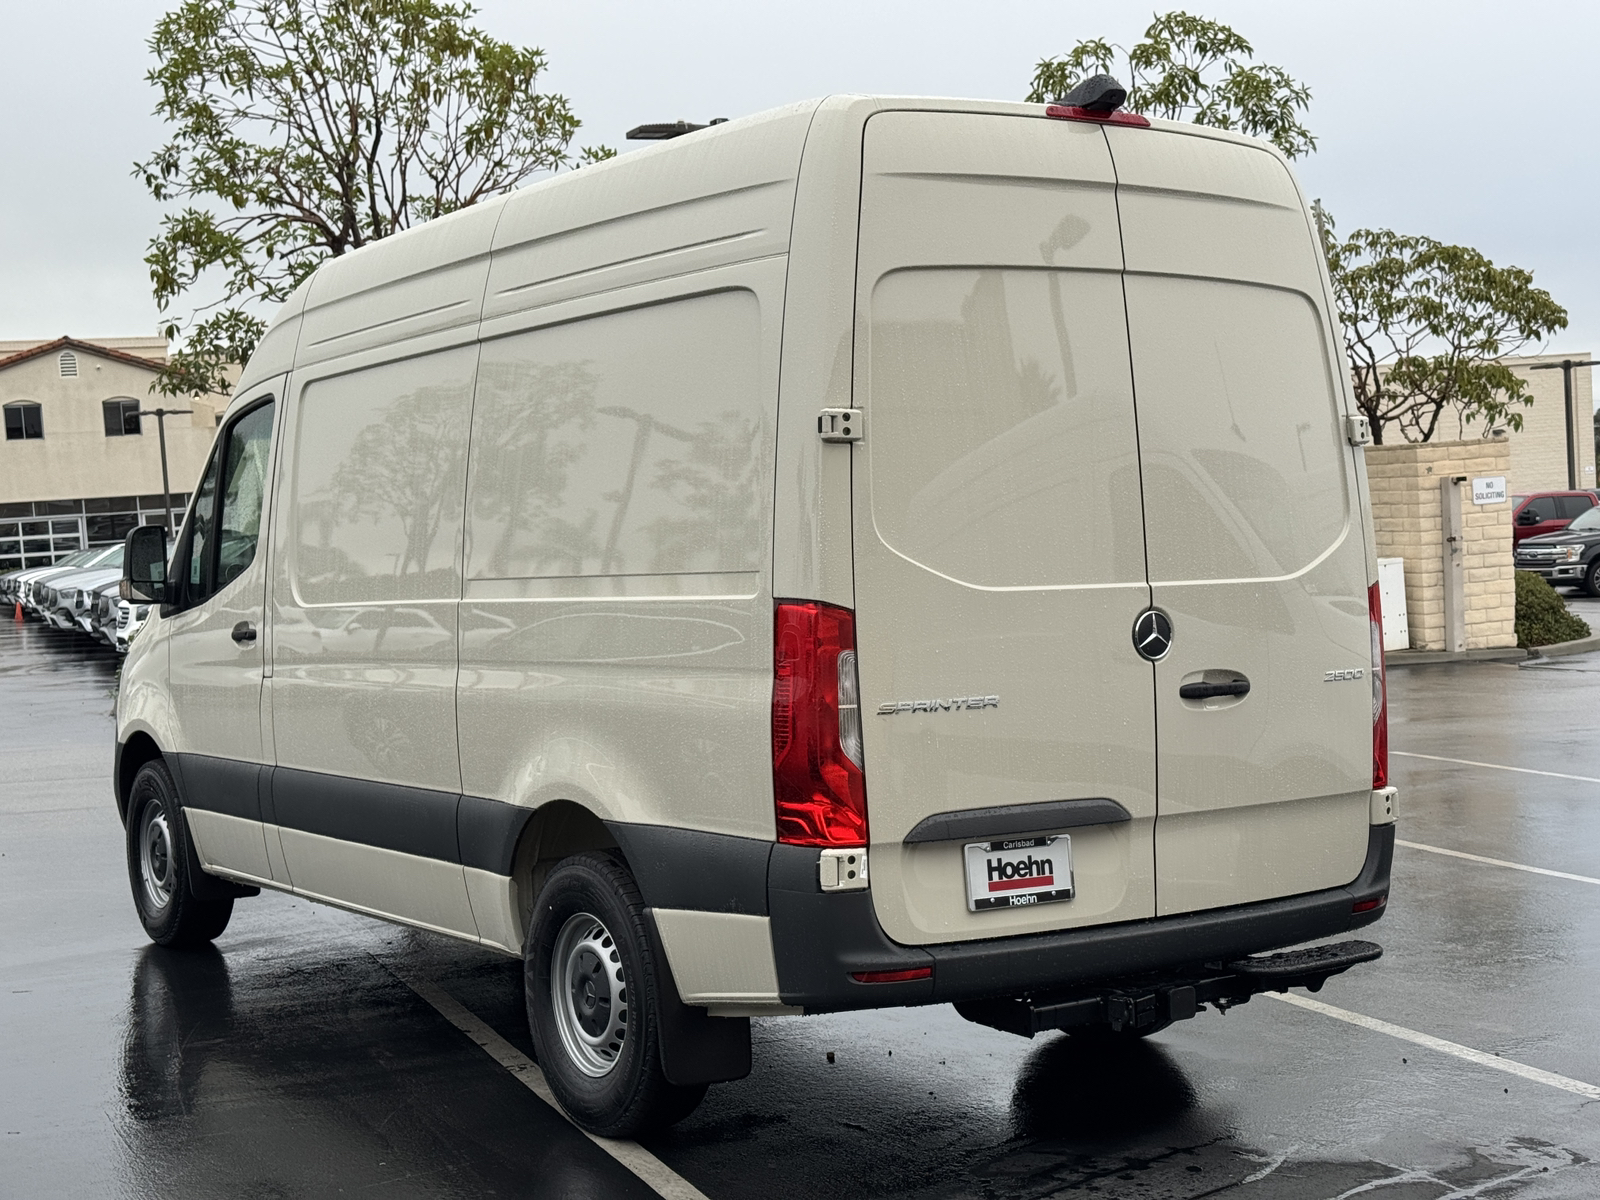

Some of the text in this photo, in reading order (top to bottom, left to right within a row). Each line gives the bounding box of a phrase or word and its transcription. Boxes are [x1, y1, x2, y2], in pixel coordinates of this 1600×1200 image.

[1485, 481, 1494, 489] NO
[1475, 491, 1504, 500] SOLICITING
[1324, 668, 1364, 682] 2500
[877, 695, 999, 715] SPRINTER
[1003, 839, 1035, 850] Carlsbad
[987, 855, 1053, 882] Hoehn
[1009, 894, 1038, 906] Hoehn
